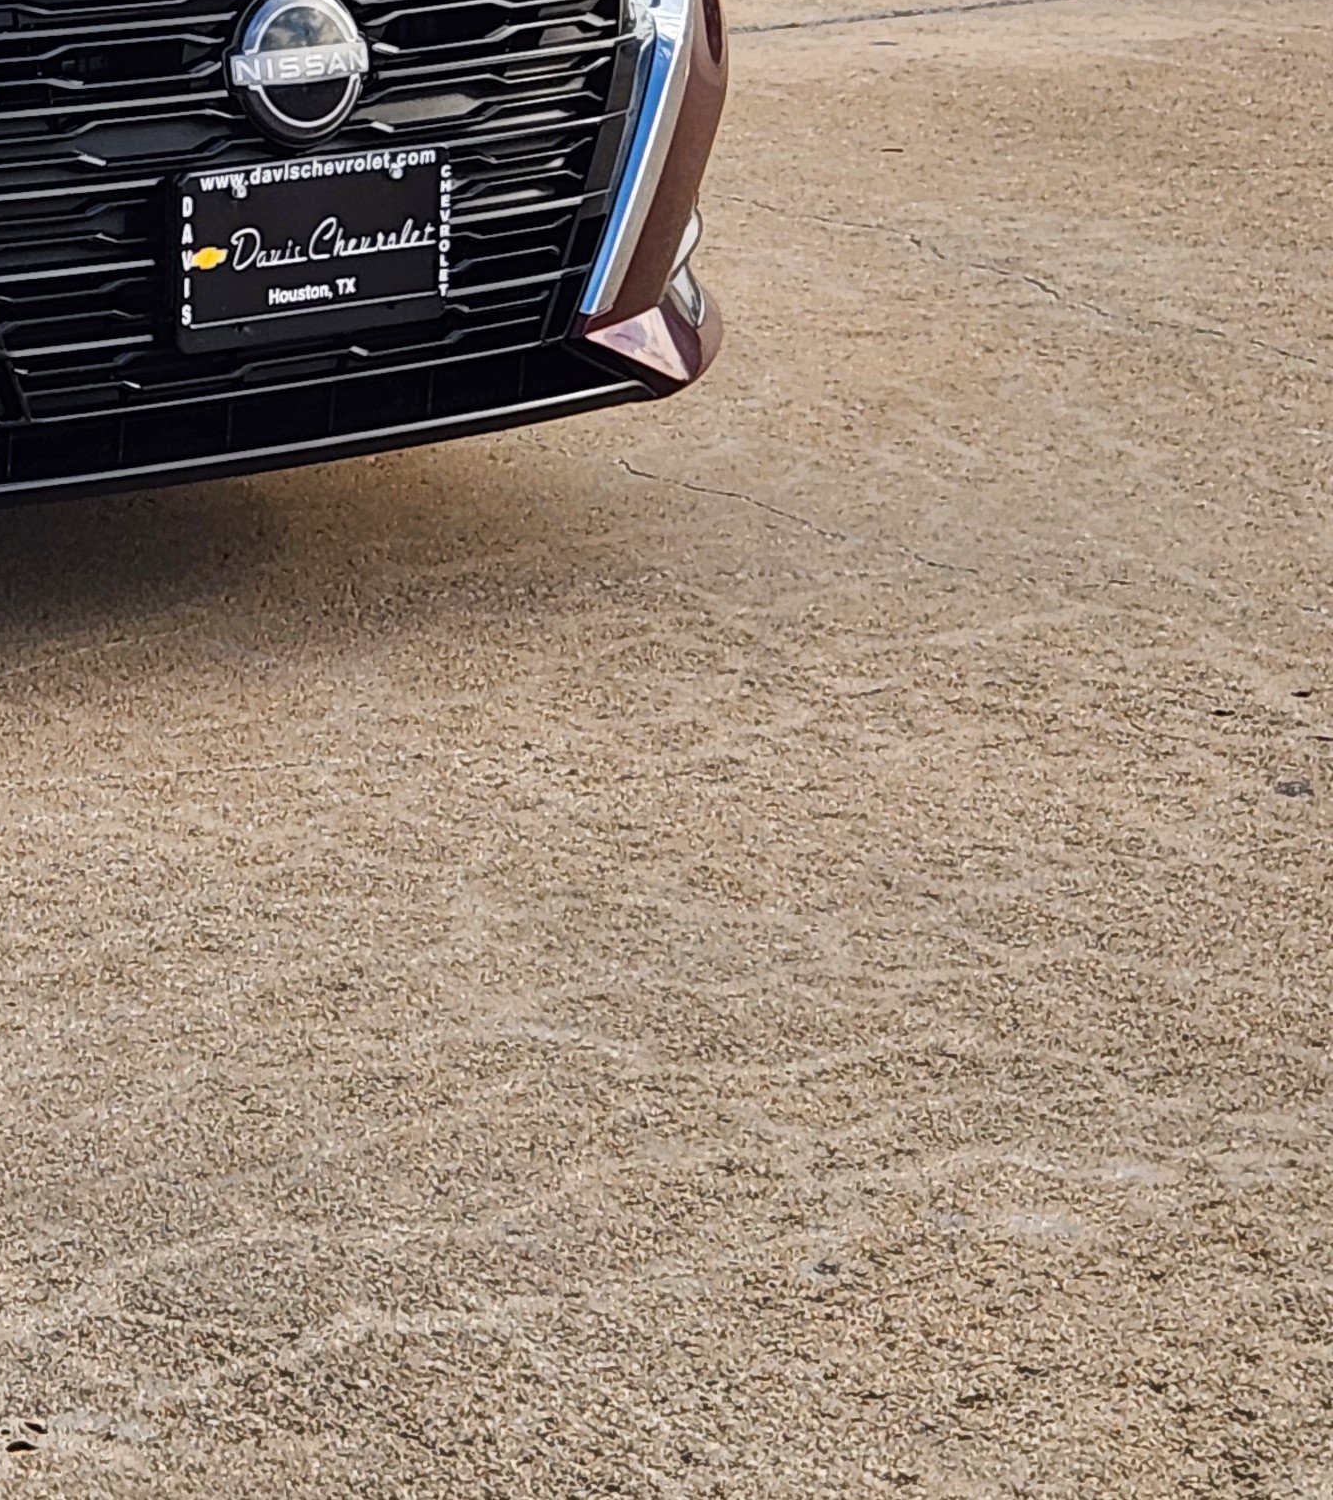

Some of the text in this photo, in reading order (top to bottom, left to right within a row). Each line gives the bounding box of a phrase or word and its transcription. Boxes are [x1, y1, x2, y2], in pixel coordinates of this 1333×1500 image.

[234, 48, 368, 83] NISSAN
[199, 149, 437, 192] www.davischevrolet.com
[230, 216, 437, 271] Davis Chevrolet
[438, 163, 453, 298] CHEVROLET
[181, 195, 195, 327] DAVIS
[267, 277, 358, 306] Houston, TX
